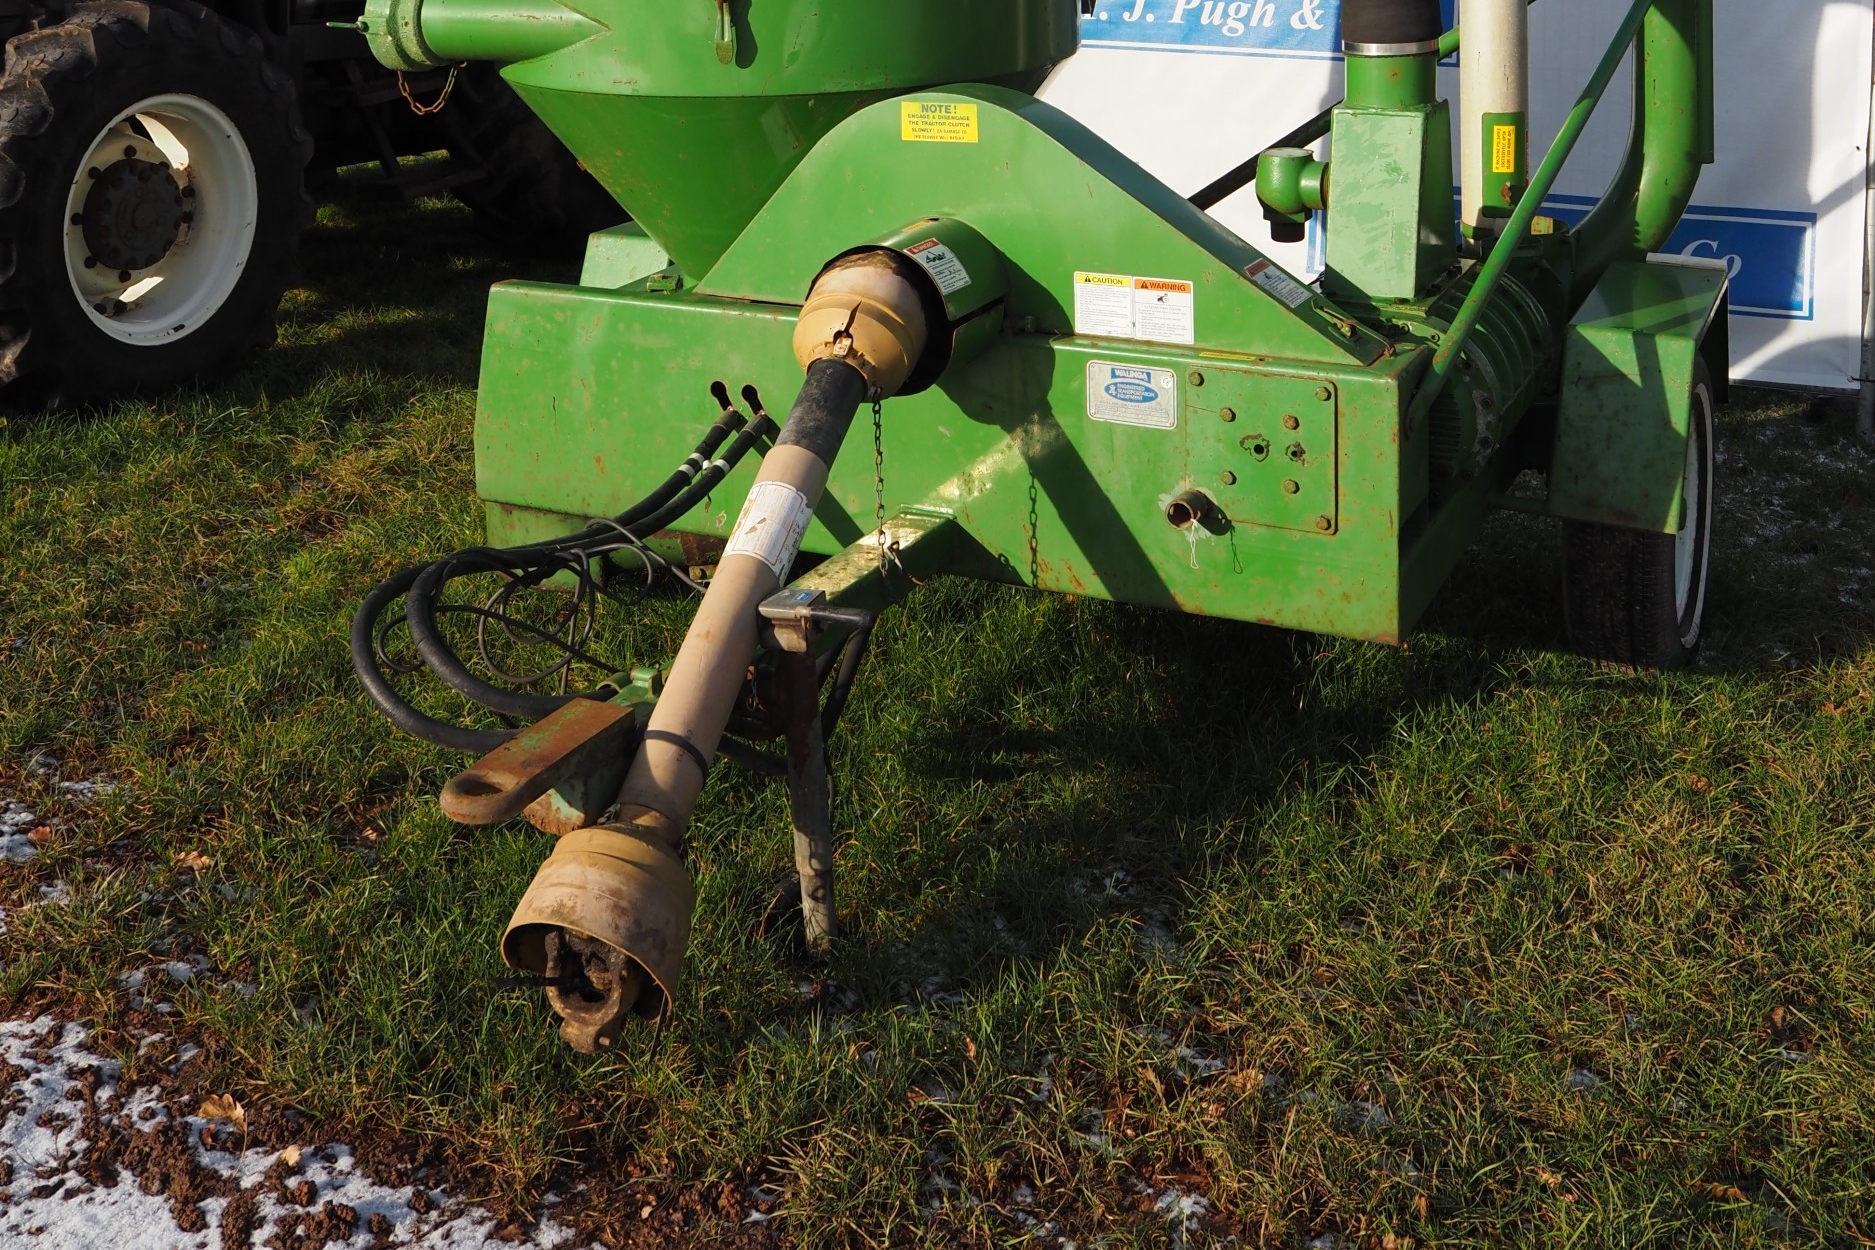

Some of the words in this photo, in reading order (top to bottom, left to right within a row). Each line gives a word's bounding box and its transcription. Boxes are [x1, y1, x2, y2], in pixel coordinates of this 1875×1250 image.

[921, 103, 957, 114] NOTE!
[1091, 276, 1123, 285] CAUTION
[1149, 281, 1186, 291] WARNING
[1114, 368, 1148, 380] WALINGA
